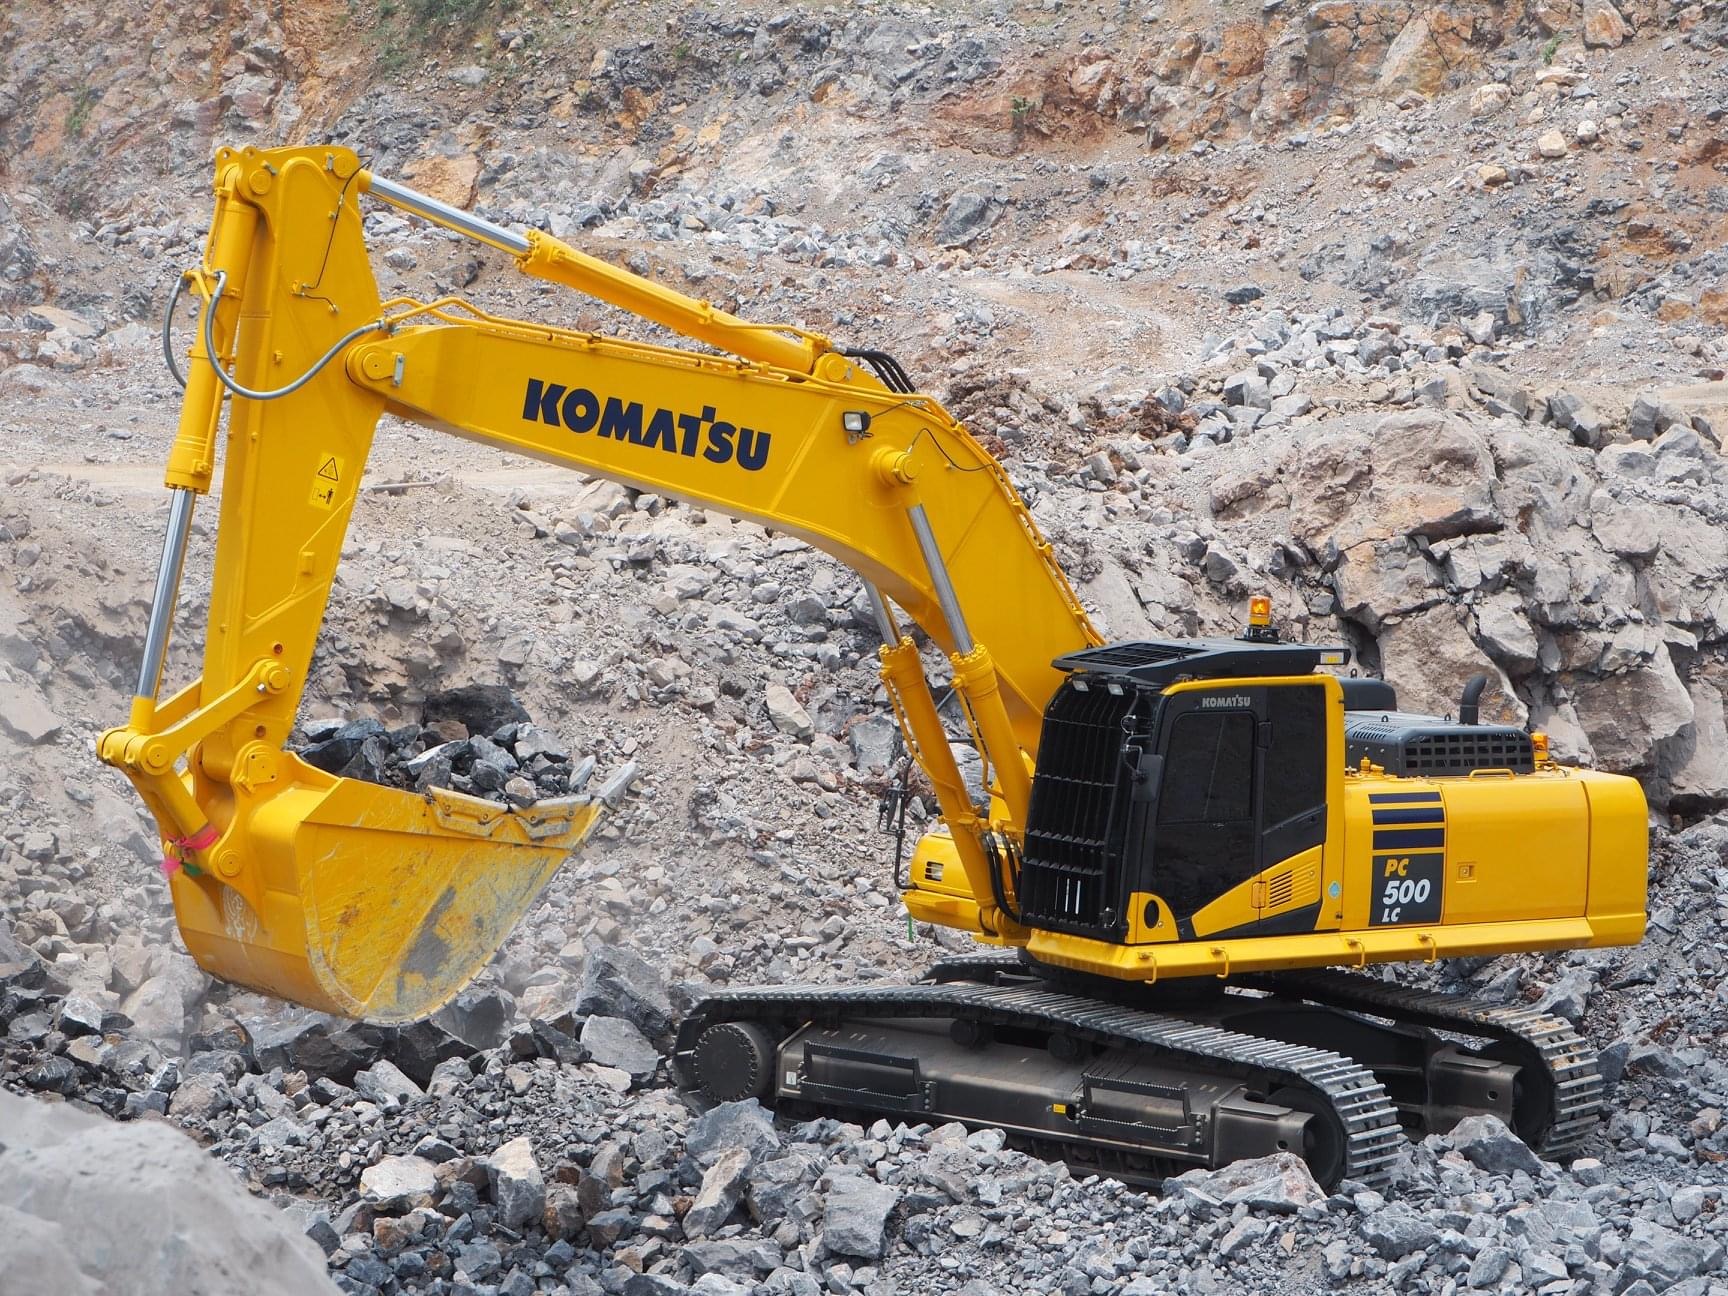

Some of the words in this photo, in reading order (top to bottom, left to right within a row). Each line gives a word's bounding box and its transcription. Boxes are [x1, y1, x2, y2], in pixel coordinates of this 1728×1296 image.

[522, 378, 772, 471] KOMATSU
[1202, 694, 1251, 708] KOMATSU
[1384, 858, 1410, 877] PC
[1382, 879, 1431, 905] 500
[1381, 907, 1401, 923] LC
